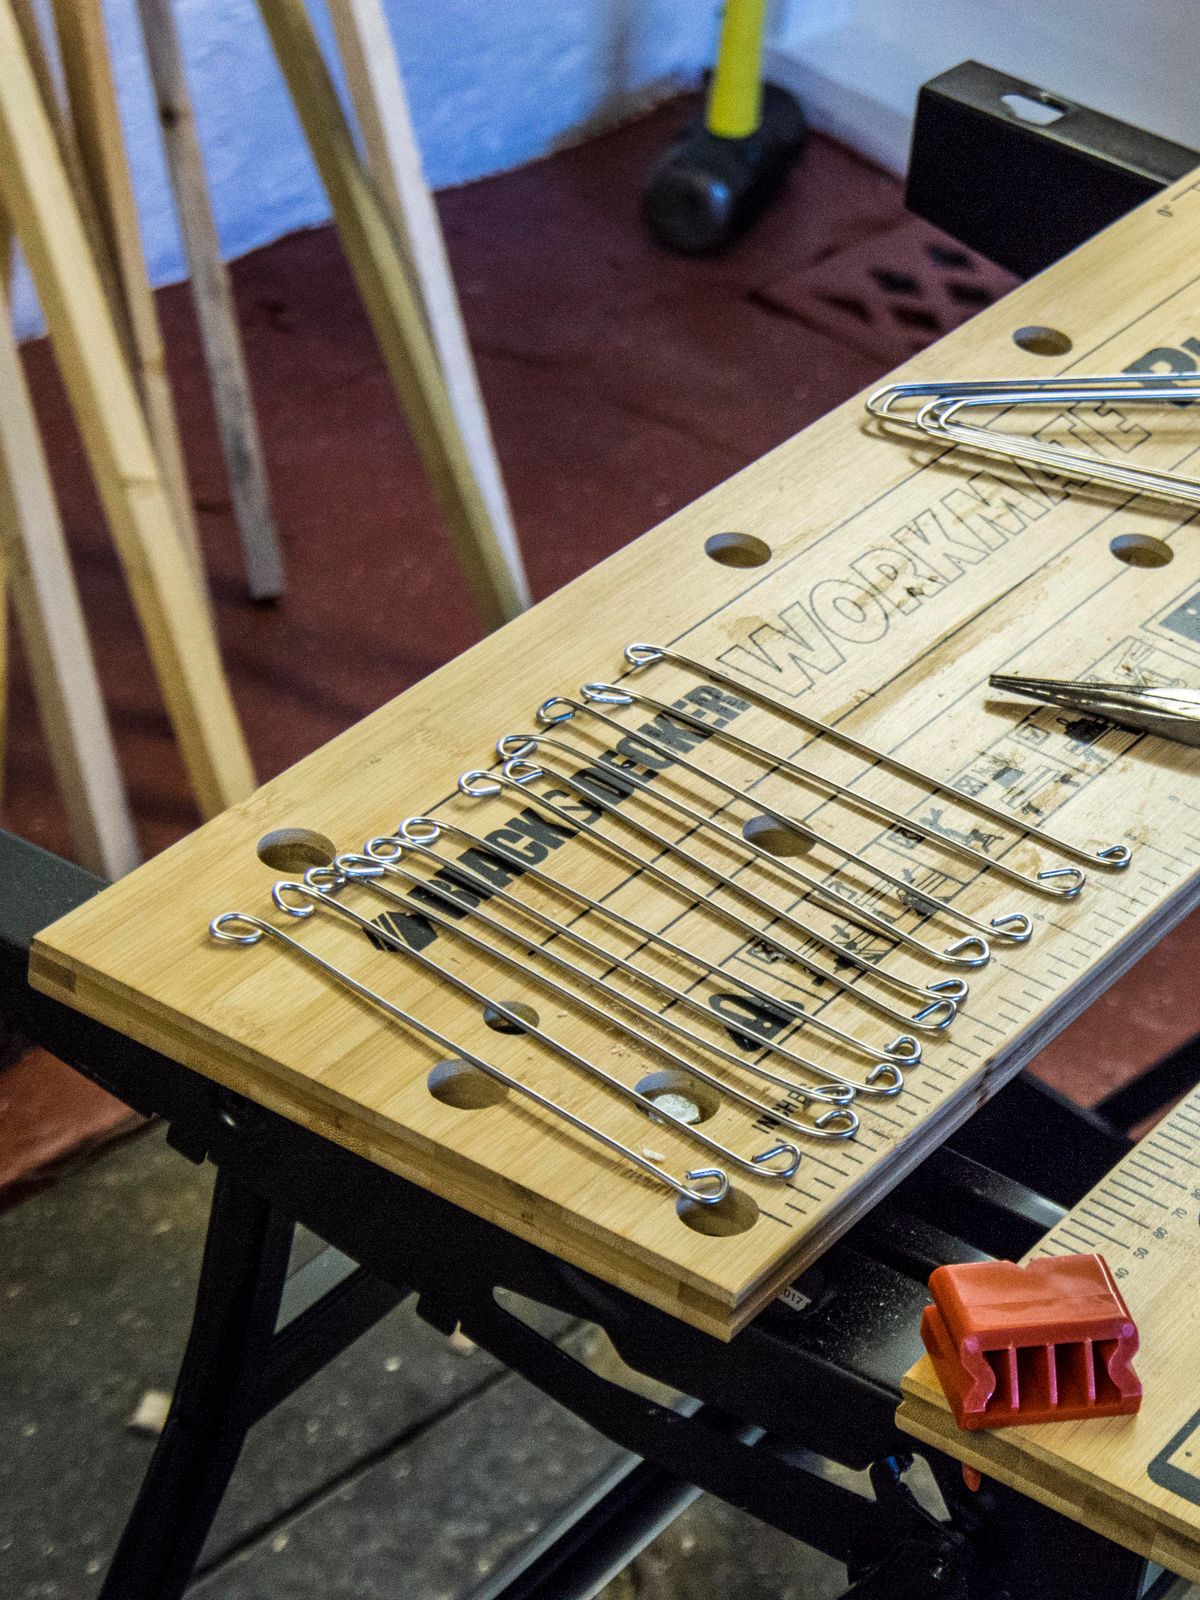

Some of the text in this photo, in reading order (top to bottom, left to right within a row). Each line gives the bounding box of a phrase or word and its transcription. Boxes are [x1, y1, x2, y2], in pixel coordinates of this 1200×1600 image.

[1114, 1267, 1130, 1280] 40
[1133, 1247, 1149, 1260] 50
[1171, 1207, 1188, 1219] 70
